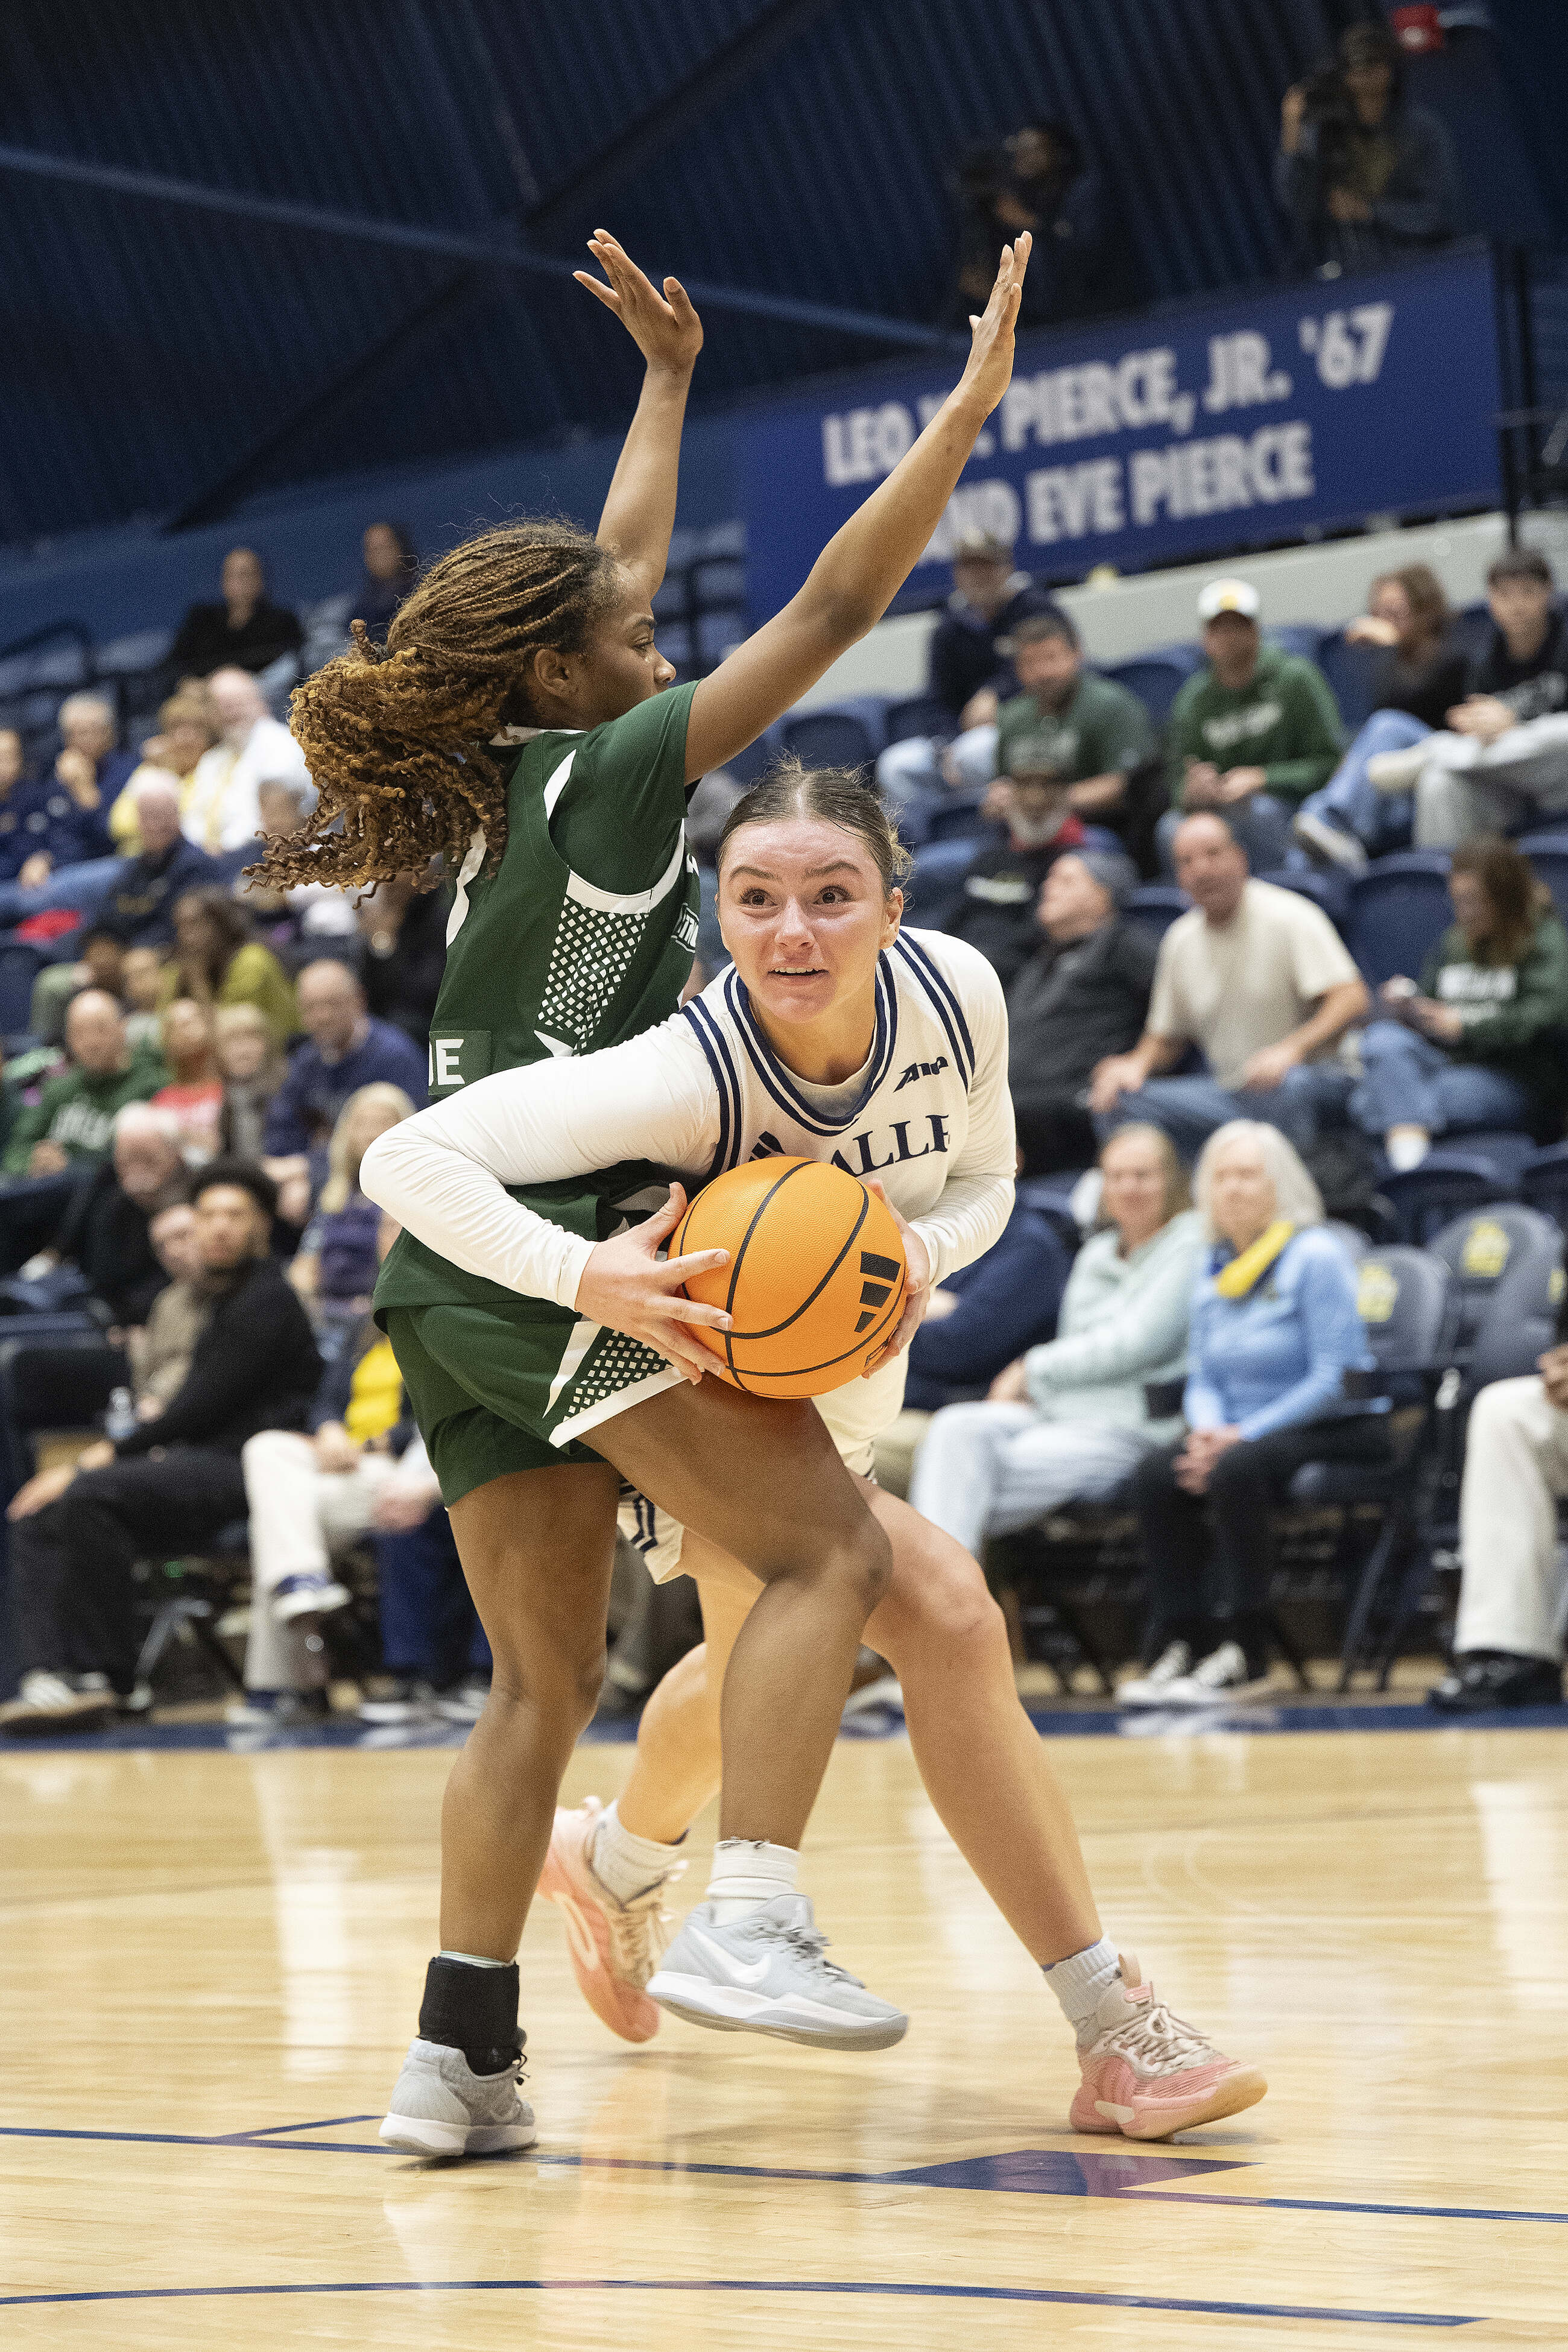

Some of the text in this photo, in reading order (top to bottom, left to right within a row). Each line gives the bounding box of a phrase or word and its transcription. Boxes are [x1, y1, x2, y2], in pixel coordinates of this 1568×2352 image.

[821, 402, 915, 485] LEO
[1001, 347, 1197, 452] PIERCE,
[1205, 330, 1292, 414] JR.
[1299, 303, 1393, 389] '67
[1027, 455, 1125, 544] EVE
[1130, 421, 1315, 526] PIERCE
[429, 1038, 466, 1087] E
